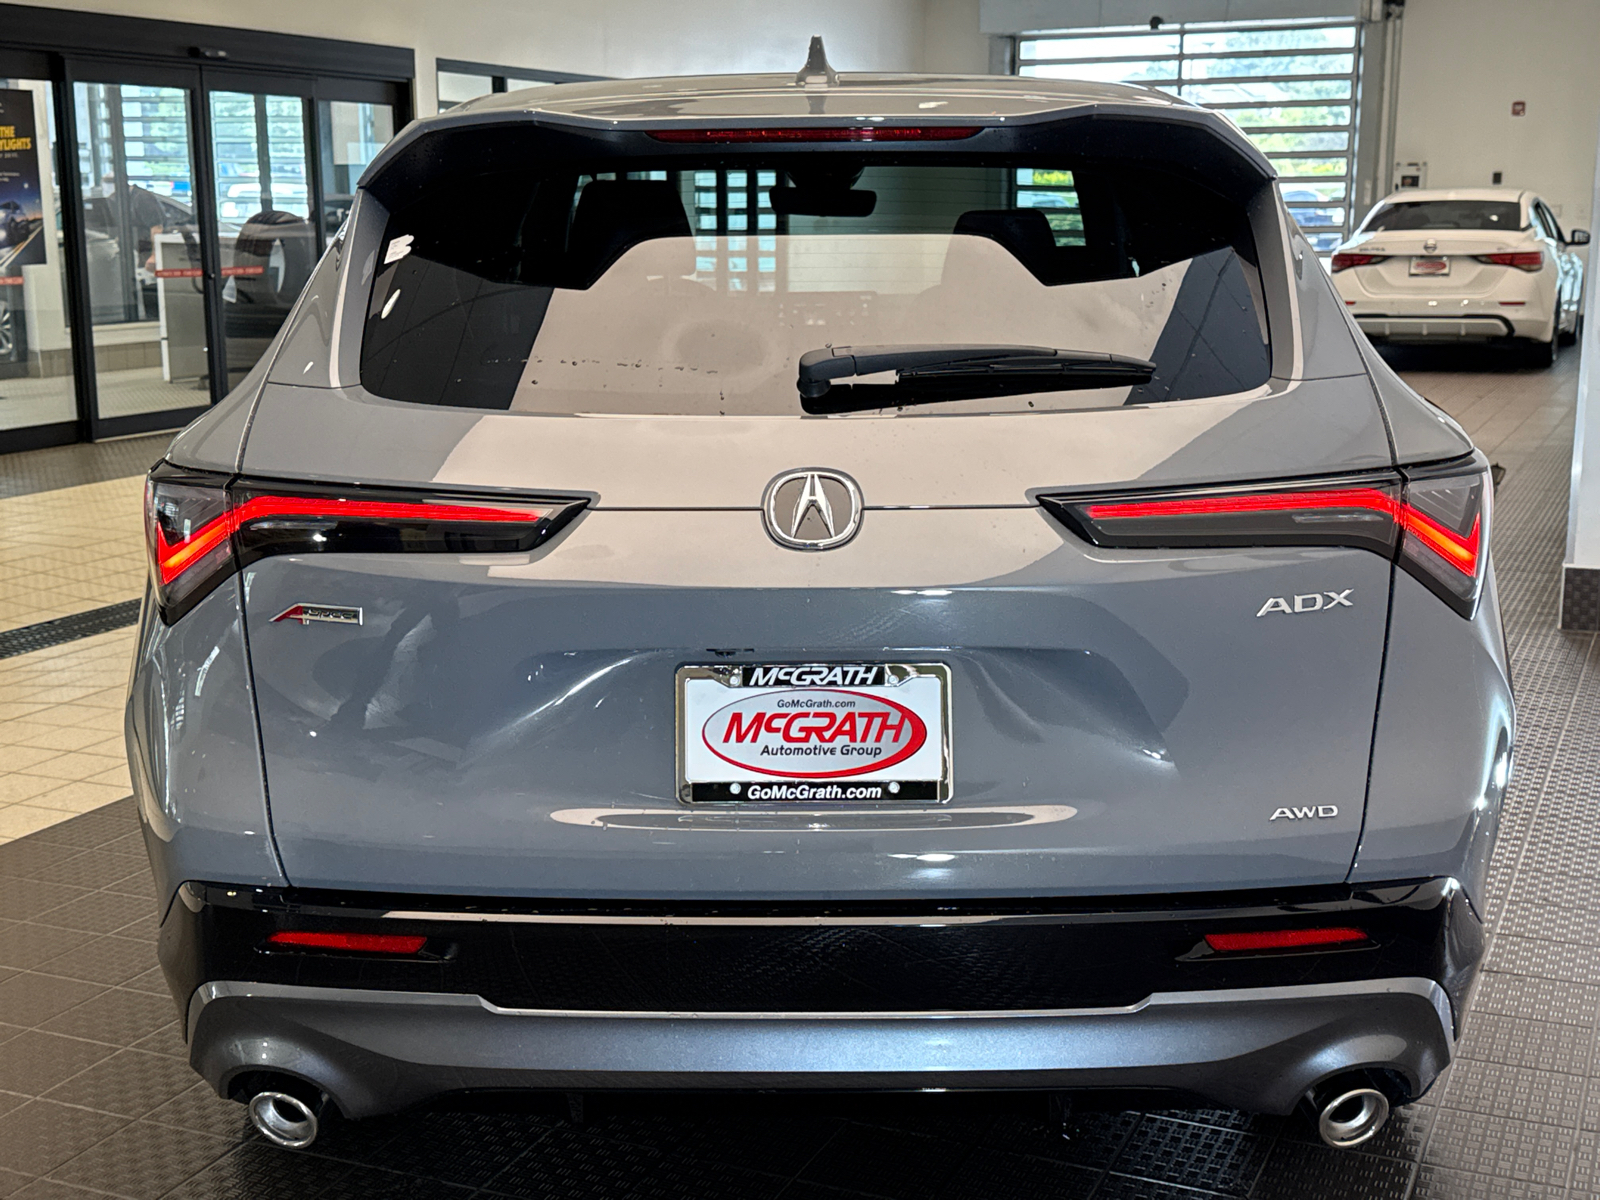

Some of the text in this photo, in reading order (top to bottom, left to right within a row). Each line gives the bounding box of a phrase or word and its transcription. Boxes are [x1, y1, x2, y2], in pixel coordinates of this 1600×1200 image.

[1256, 588, 1354, 617] ADX
[749, 667, 878, 686] McGRATH
[777, 699, 856, 708] GoMcGrath.com
[722, 711, 905, 743] McGRATH
[760, 744, 883, 758] Automotive Group
[747, 785, 882, 800] GoMcGrath.com
[1269, 804, 1339, 821] AWD
